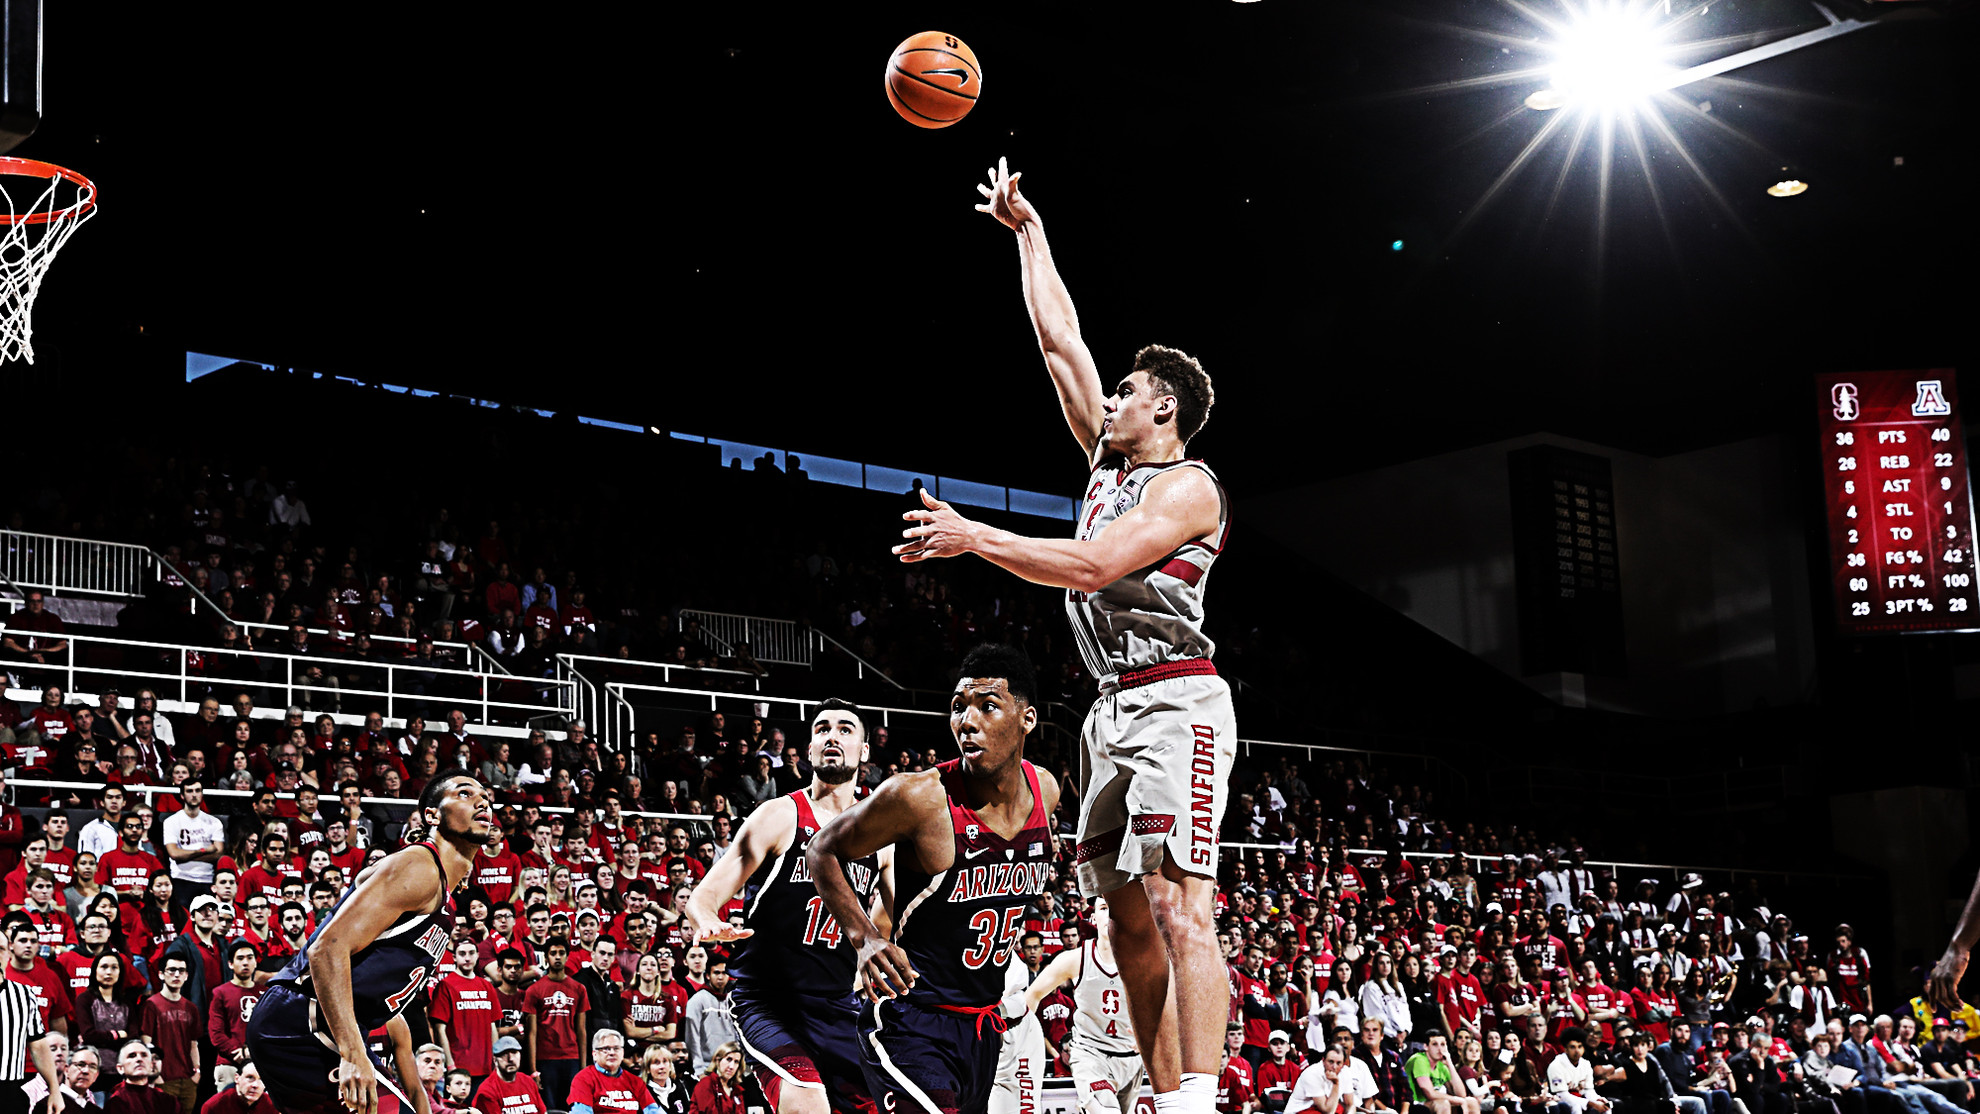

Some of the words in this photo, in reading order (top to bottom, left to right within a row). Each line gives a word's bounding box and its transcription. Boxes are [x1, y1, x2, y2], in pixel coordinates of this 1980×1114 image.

[1911, 380, 1951, 417] A
[1836, 432, 1854, 446] 36
[1878, 430, 1907, 444] PTS
[1931, 428, 1950, 442] 40
[1838, 457, 1857, 471] 26
[1880, 455, 1910, 469] REB
[1934, 453, 1953, 467] 22
[1845, 480, 1856, 494] 5
[1883, 479, 1911, 493] AST
[1941, 477, 1952, 491] 9
[1847, 505, 1857, 519] 4
[1885, 503, 1913, 517] STL
[1944, 501, 1953, 515] 1
[1848, 529, 1859, 543] 2
[1890, 527, 1913, 540] TO
[1946, 525, 1957, 539] 3
[1847, 553, 1866, 567] 36
[1886, 552, 1905, 565] FG
[1906, 551, 1923, 564] %
[1943, 550, 1962, 563] 42
[1850, 578, 1868, 592] 60
[1888, 576, 1906, 589] FT
[1908, 575, 1925, 588] %
[1943, 574, 1969, 588] 100
[1852, 602, 1870, 616] 25
[1886, 600, 1915, 614] 3PT
[1917, 599, 1934, 612] %
[1948, 598, 1967, 612] 28
[1191, 724, 1214, 866] STANFORD
[803, 896, 842, 949] 14
[962, 905, 1026, 970] 35
[1106, 1020, 1117, 1038] 4
